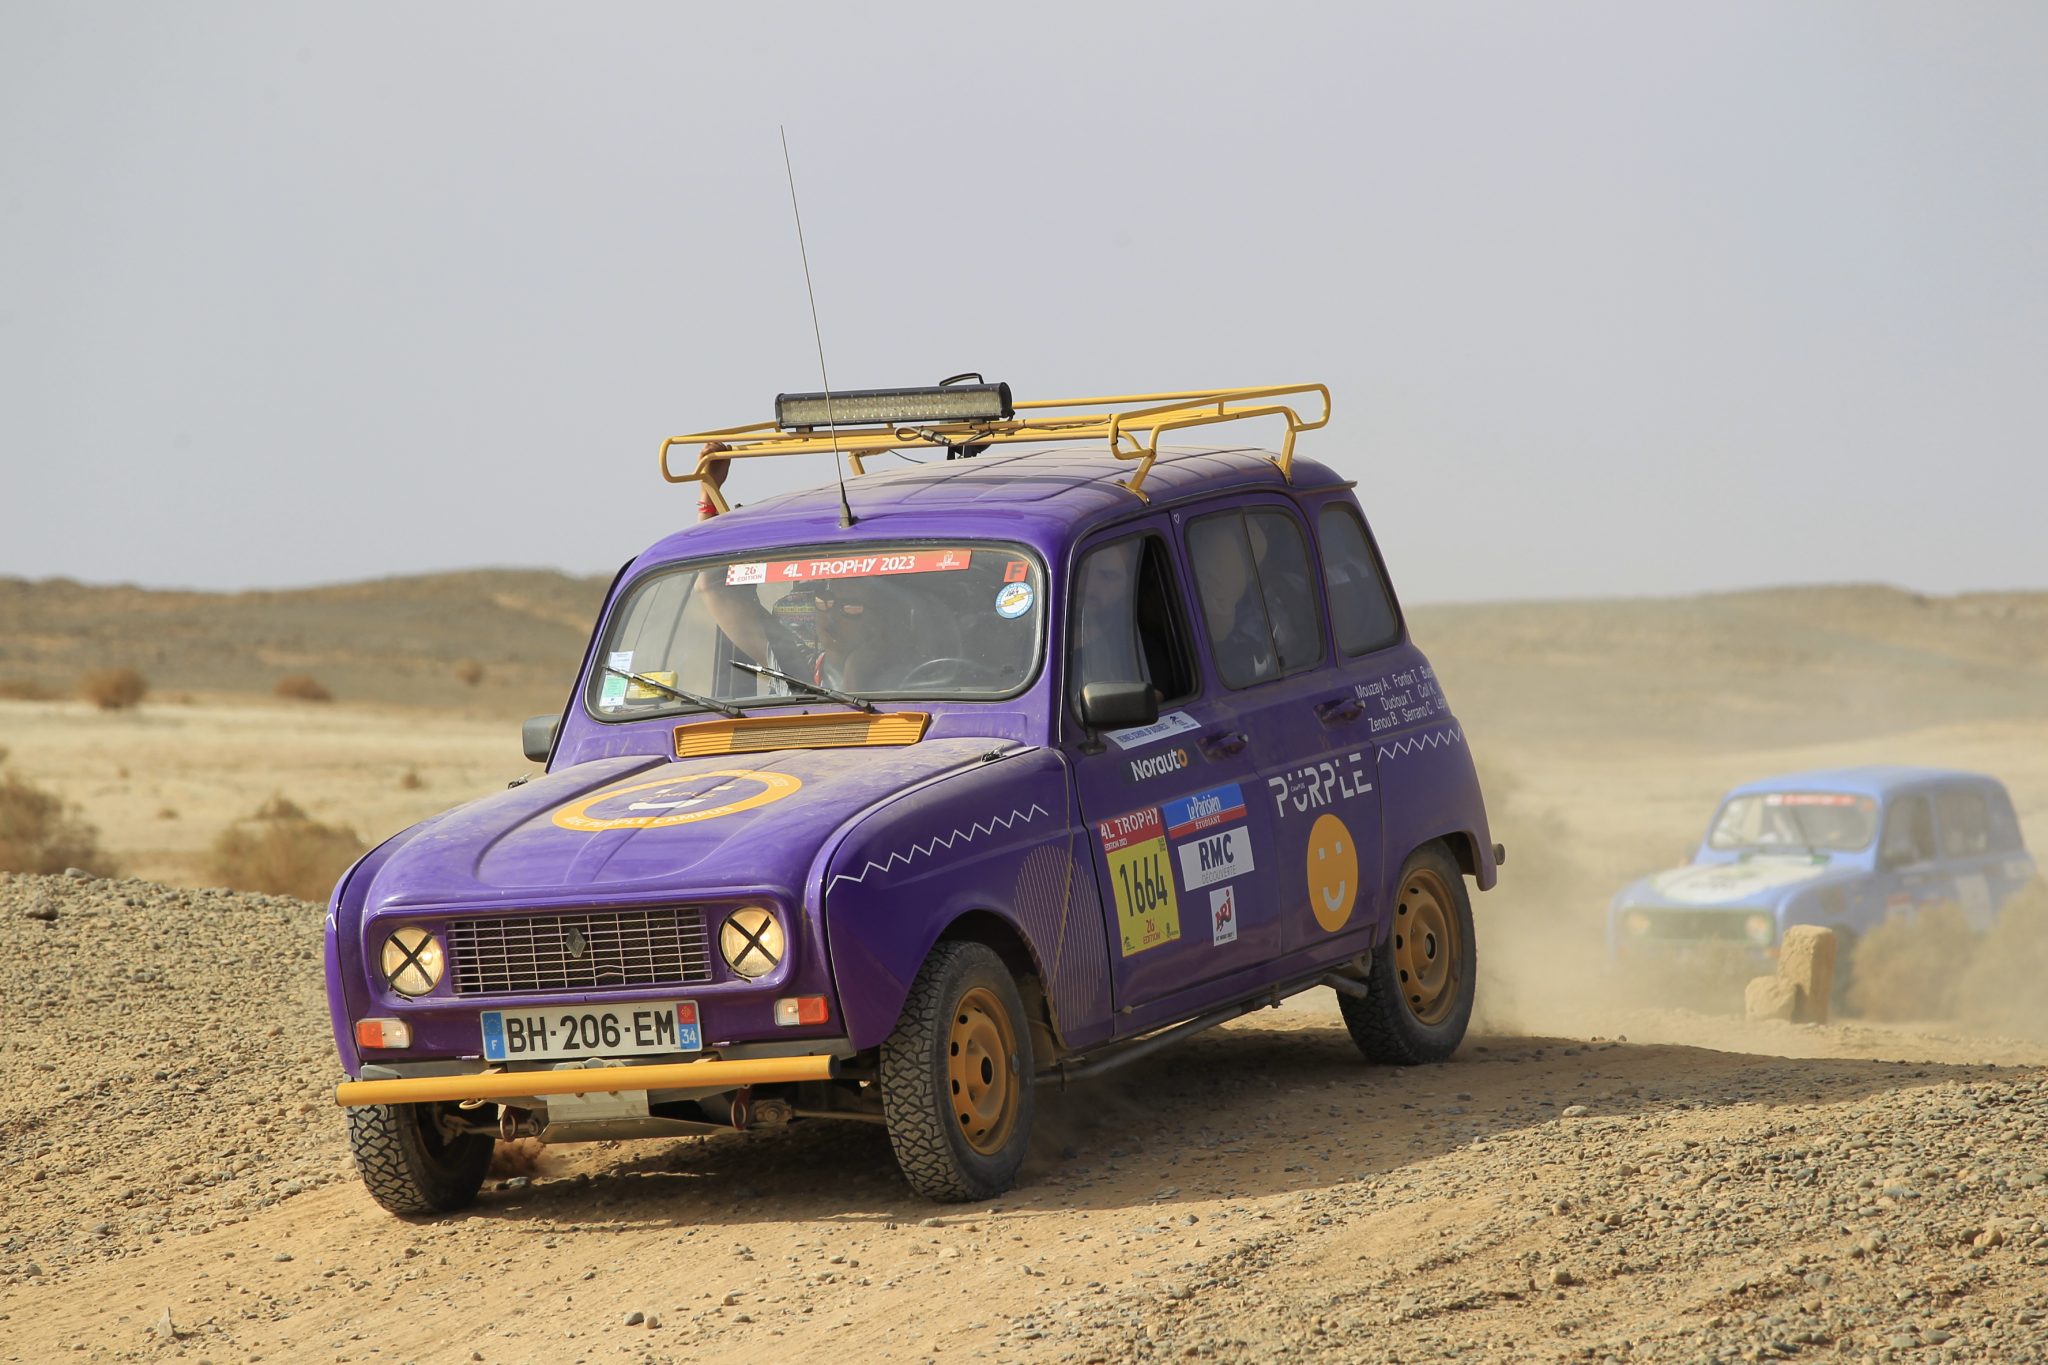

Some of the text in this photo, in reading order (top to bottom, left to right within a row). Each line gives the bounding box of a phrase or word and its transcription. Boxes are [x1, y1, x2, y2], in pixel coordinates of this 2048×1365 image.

[744, 566, 757, 575] 26
[782, 555, 916, 578] 4L TROPHY 2023
[1008, 564, 1024, 579] F
[1368, 717, 1392, 732] Zenou
[1130, 748, 1188, 782] Norauto
[1268, 752, 1373, 818] PURPLE
[1100, 807, 1159, 840] 4L TROPHY
[1198, 834, 1234, 871] RMC
[1119, 853, 1168, 917] 1664
[491, 1039, 499, 1050] F
[681, 1027, 697, 1044] 34
